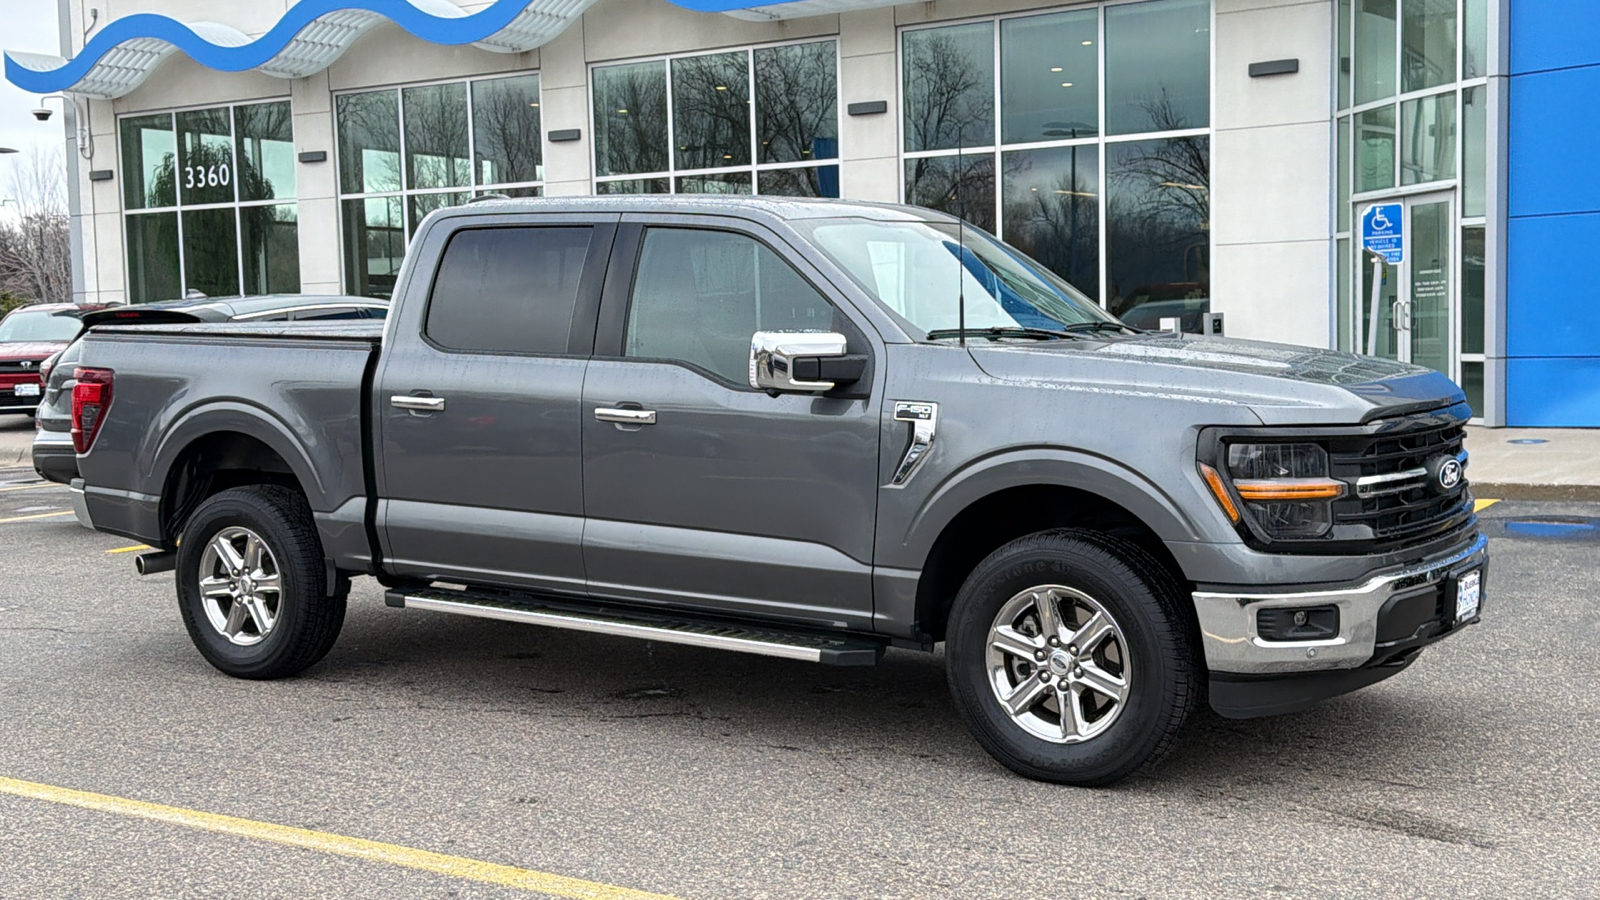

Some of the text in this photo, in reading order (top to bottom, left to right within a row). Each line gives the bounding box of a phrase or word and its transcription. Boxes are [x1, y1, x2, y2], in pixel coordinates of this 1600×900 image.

[185, 163, 230, 189] 3360
[897, 404, 932, 413] F-150
[1444, 464, 1459, 485] Ford
